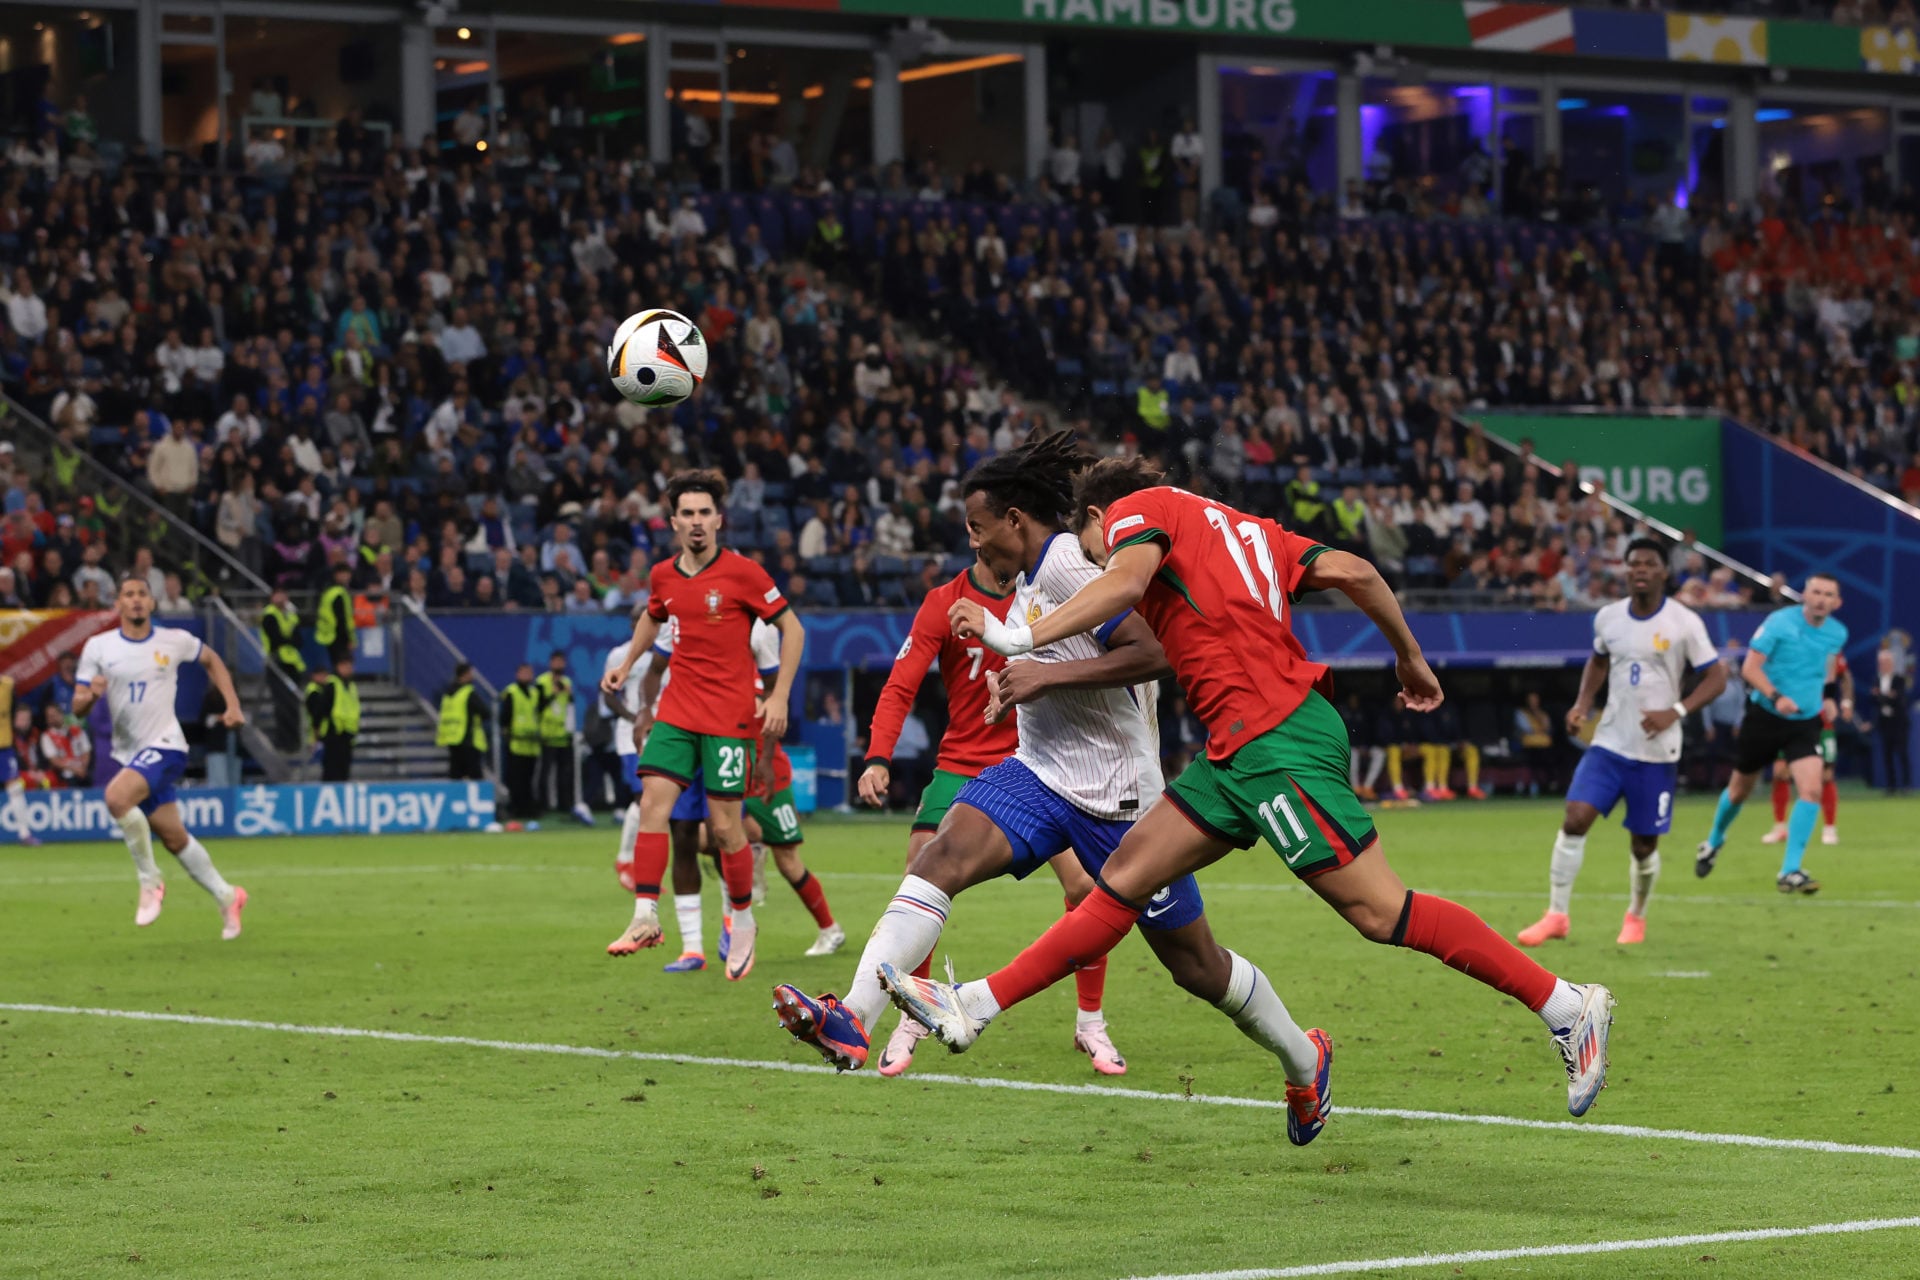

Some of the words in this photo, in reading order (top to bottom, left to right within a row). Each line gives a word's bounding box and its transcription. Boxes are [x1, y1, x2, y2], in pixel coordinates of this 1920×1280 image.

[1203, 506, 1282, 622] 11
[966, 647, 984, 681] 7
[1629, 663, 1641, 686] 8
[128, 681, 148, 704] 17
[718, 746, 745, 778] 23
[772, 803, 798, 832] 10
[1258, 793, 1310, 849] 11
